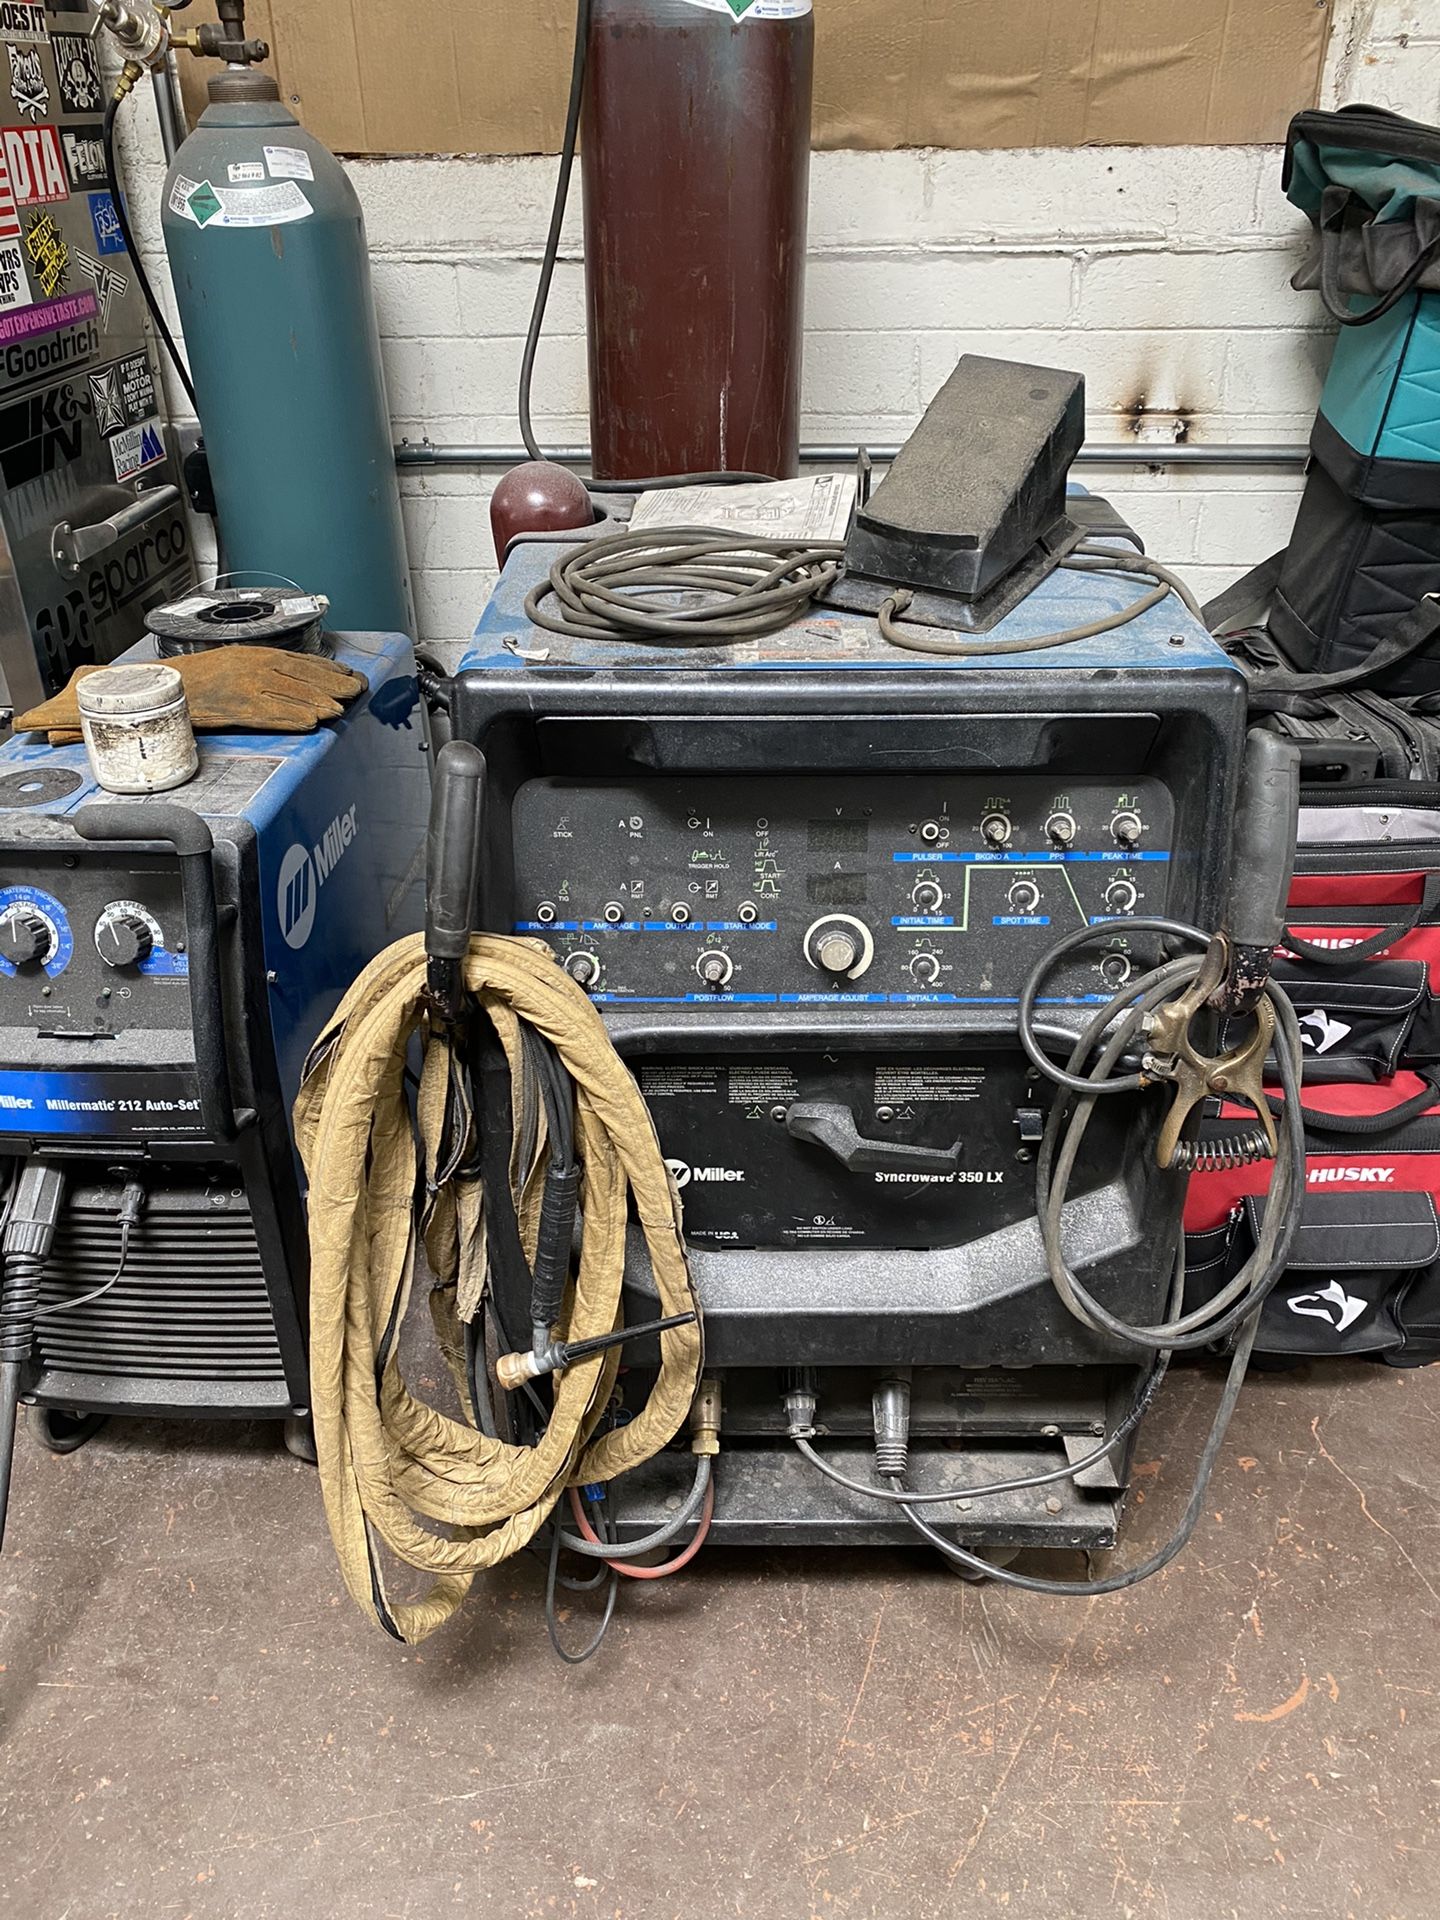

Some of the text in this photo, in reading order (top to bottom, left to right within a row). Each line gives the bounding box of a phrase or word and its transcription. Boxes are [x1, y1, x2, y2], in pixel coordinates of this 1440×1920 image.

[3, 129, 66, 199] DTA
[122, 374, 152, 394] MOTOR
[88, 519, 185, 615] sparco
[314, 802, 356, 887] Miller
[4, 888, 32, 896] MATERIAL
[106, 901, 146, 912] WIRE SPEED
[46, 1099, 201, 1111] Millermatic 212 Auto-Set
[693, 1167, 744, 1181] Miller
[875, 1172, 1004, 1183] Syncrowave 350 LX
[1308, 1167, 1395, 1183] HUSKY
